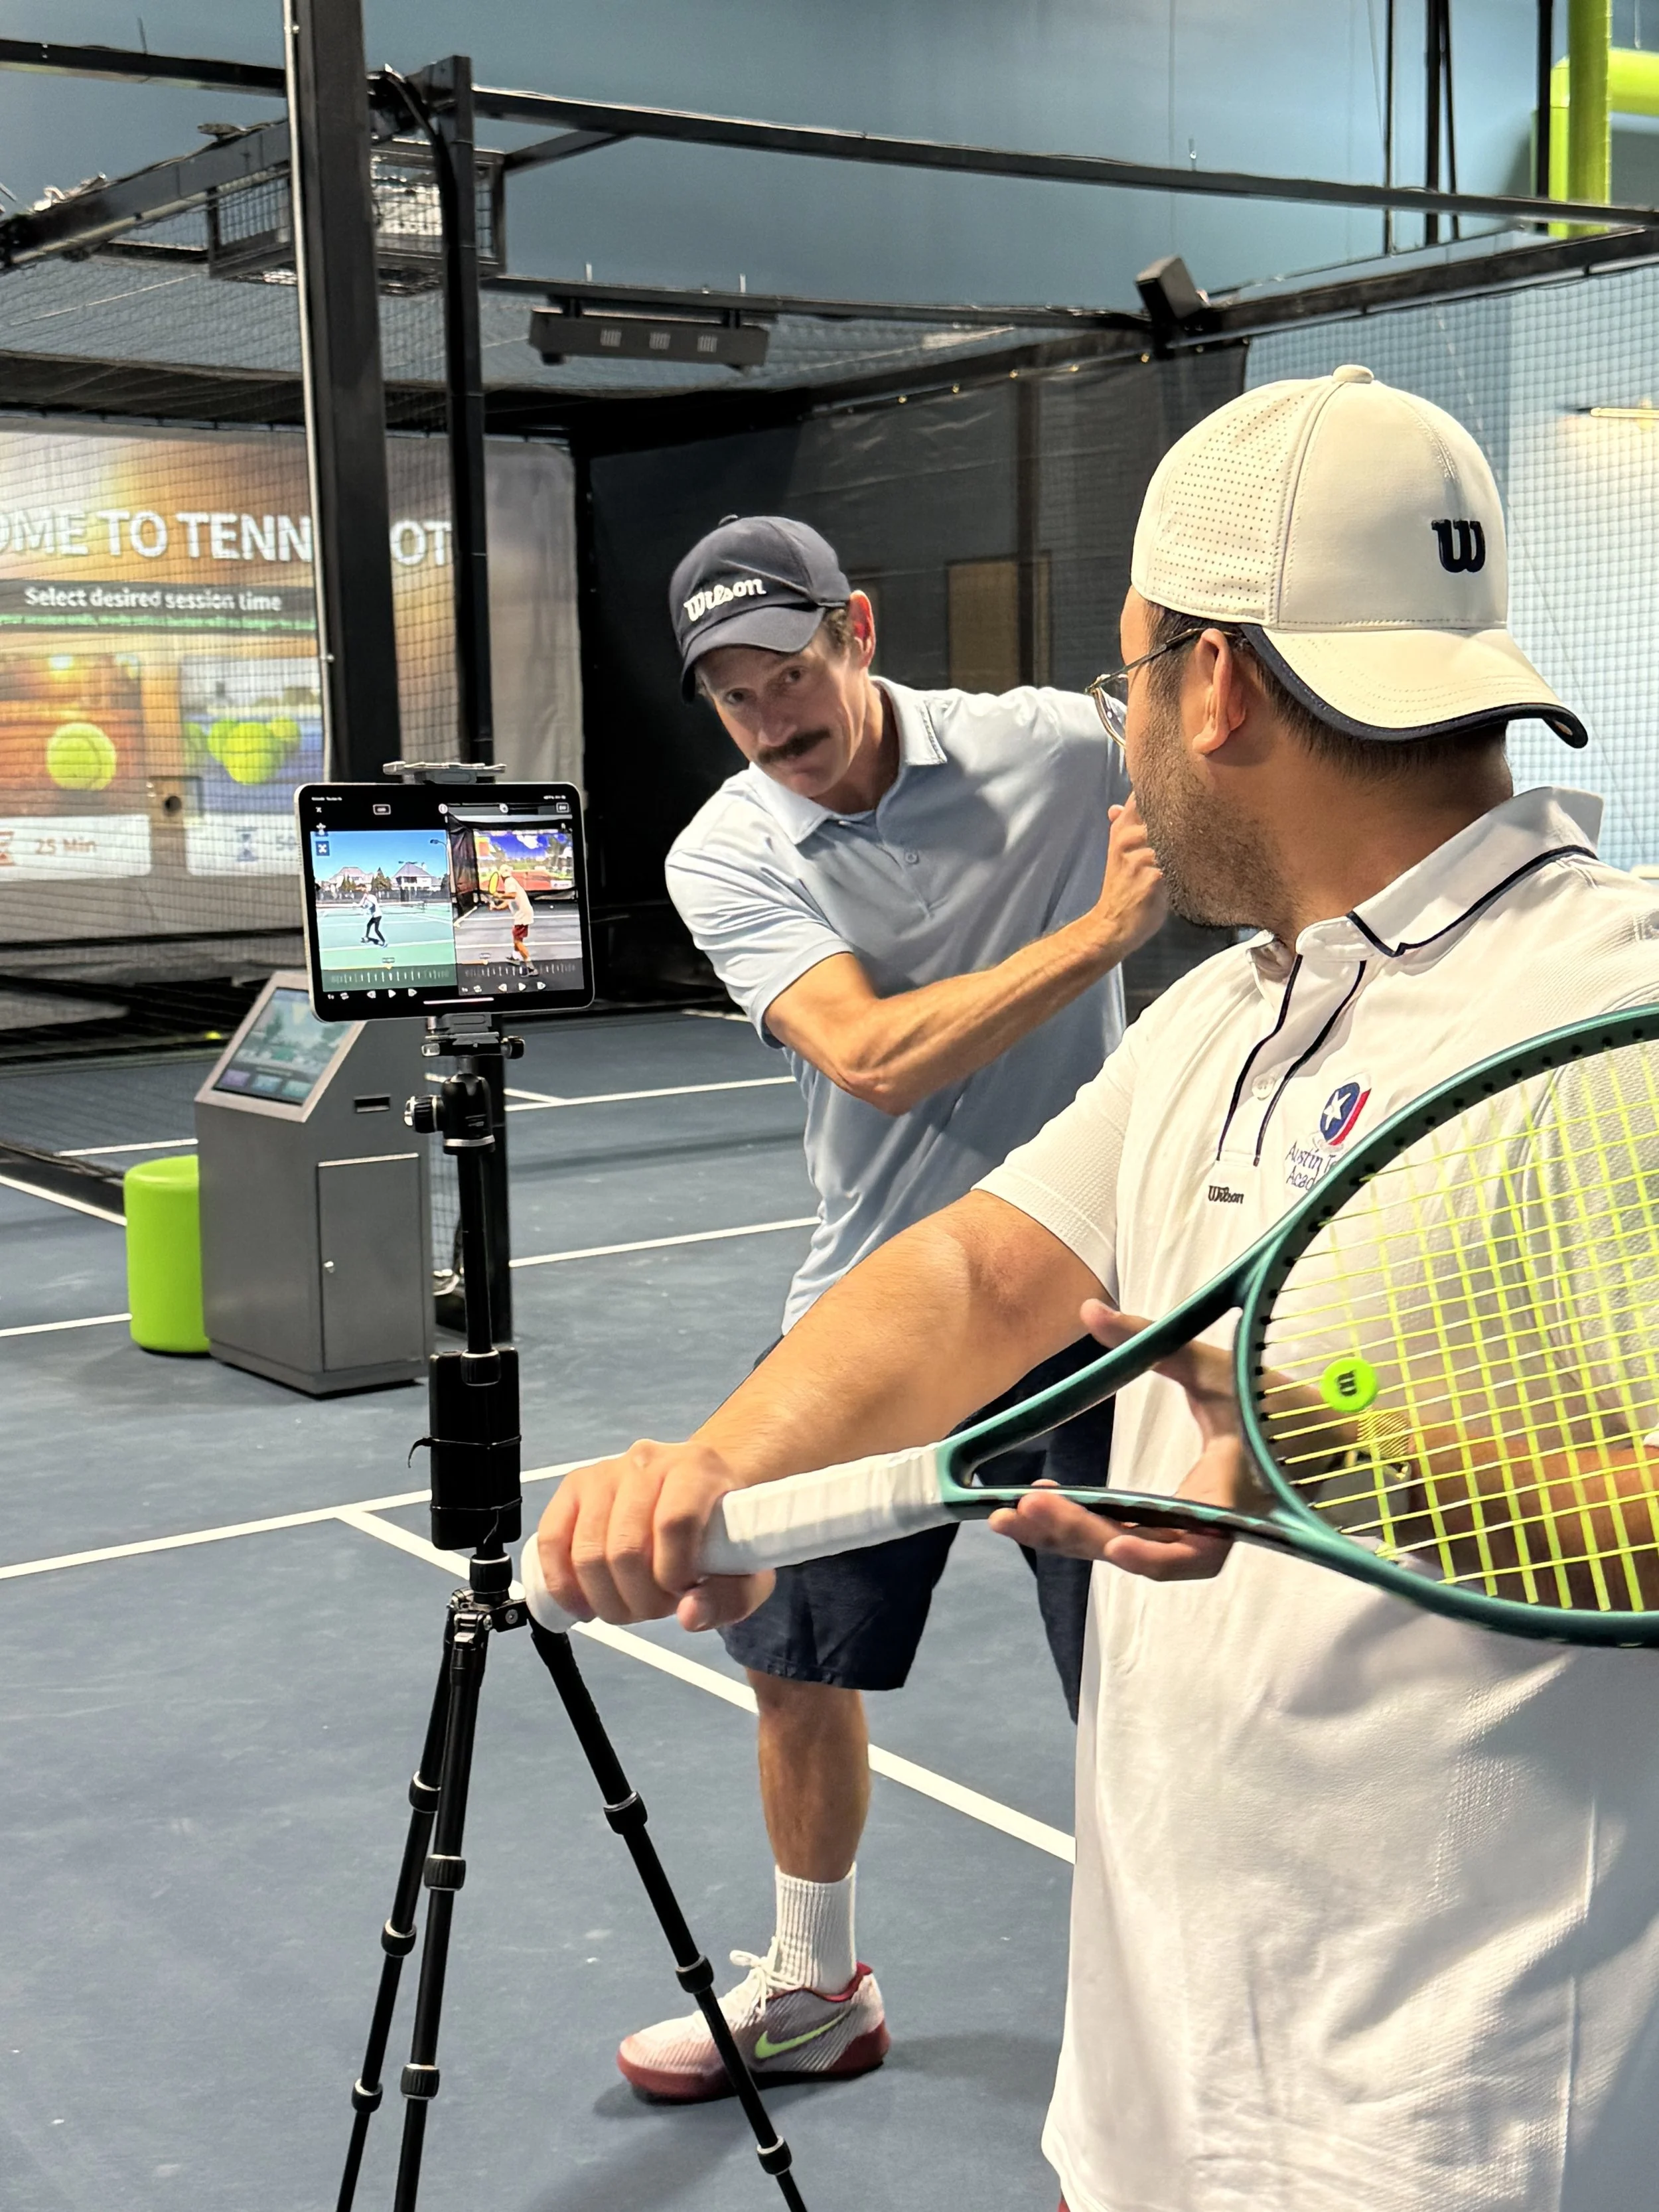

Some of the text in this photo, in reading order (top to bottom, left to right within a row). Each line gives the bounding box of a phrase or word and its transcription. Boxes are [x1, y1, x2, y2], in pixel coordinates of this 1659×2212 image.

[0, 509, 89, 555] ME
[97, 510, 167, 557] TO
[25, 587, 282, 611] Select desired session time
[684, 578, 767, 622] Wilson
[35, 837, 97, 855] 25 Min
[1285, 1140, 1323, 1170] Austin
[1208, 1185, 1244, 1204] Wilson
